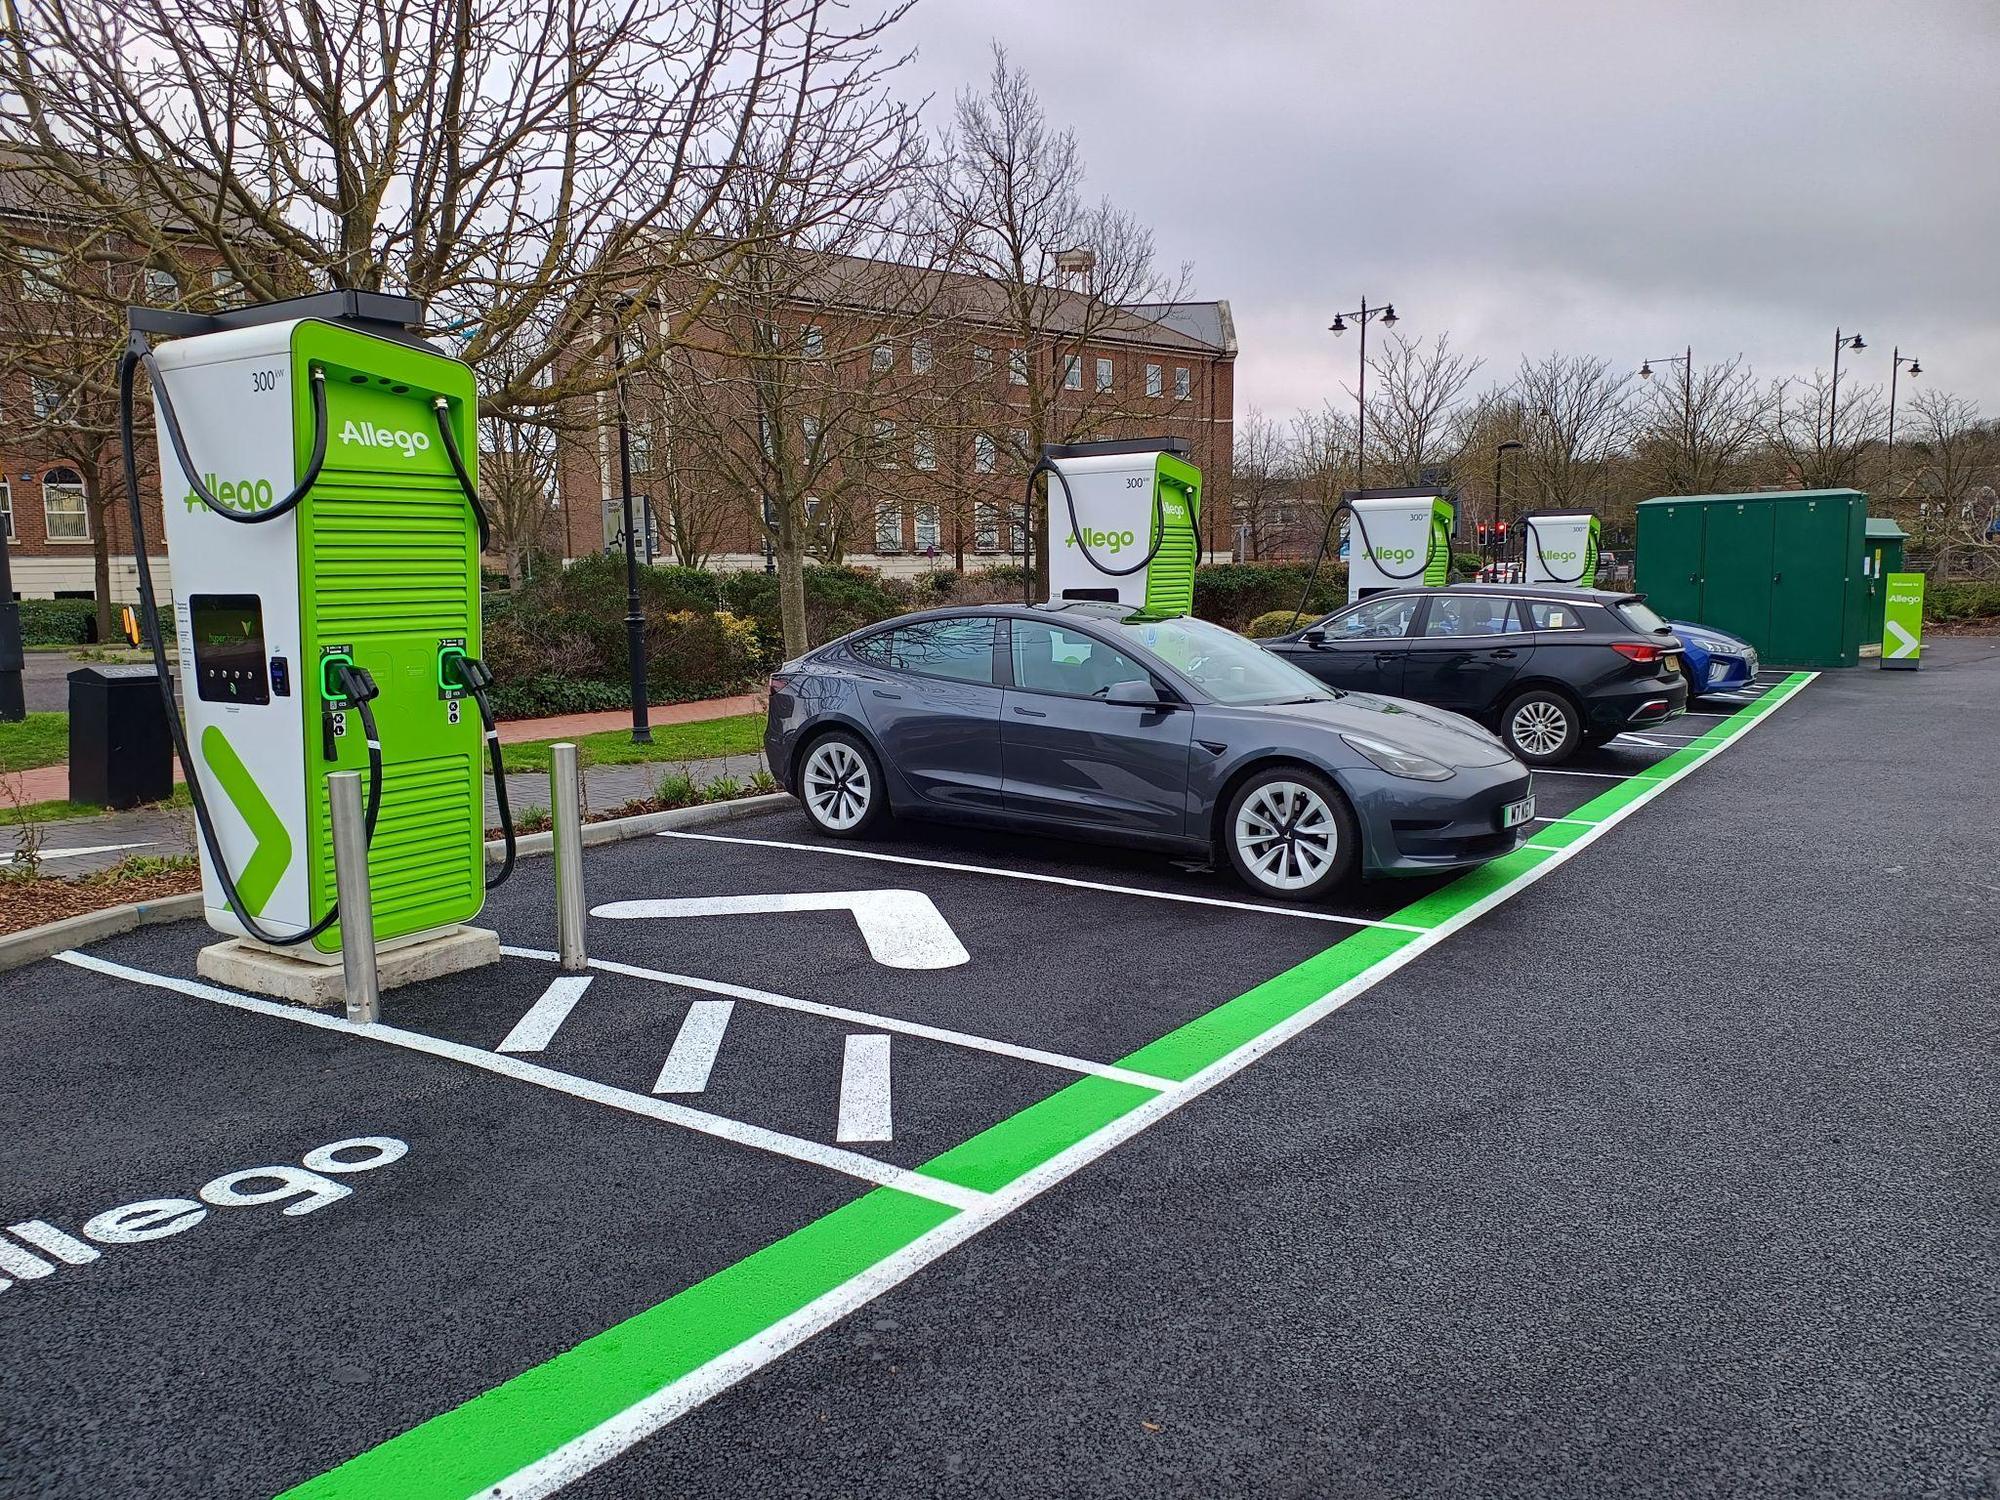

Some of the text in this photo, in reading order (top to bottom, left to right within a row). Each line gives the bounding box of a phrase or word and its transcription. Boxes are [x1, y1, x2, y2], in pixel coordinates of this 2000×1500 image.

[338, 420, 430, 457] Allego
[1889, 595, 1921, 605] Allego
[0, 1136, 409, 1294] llego
